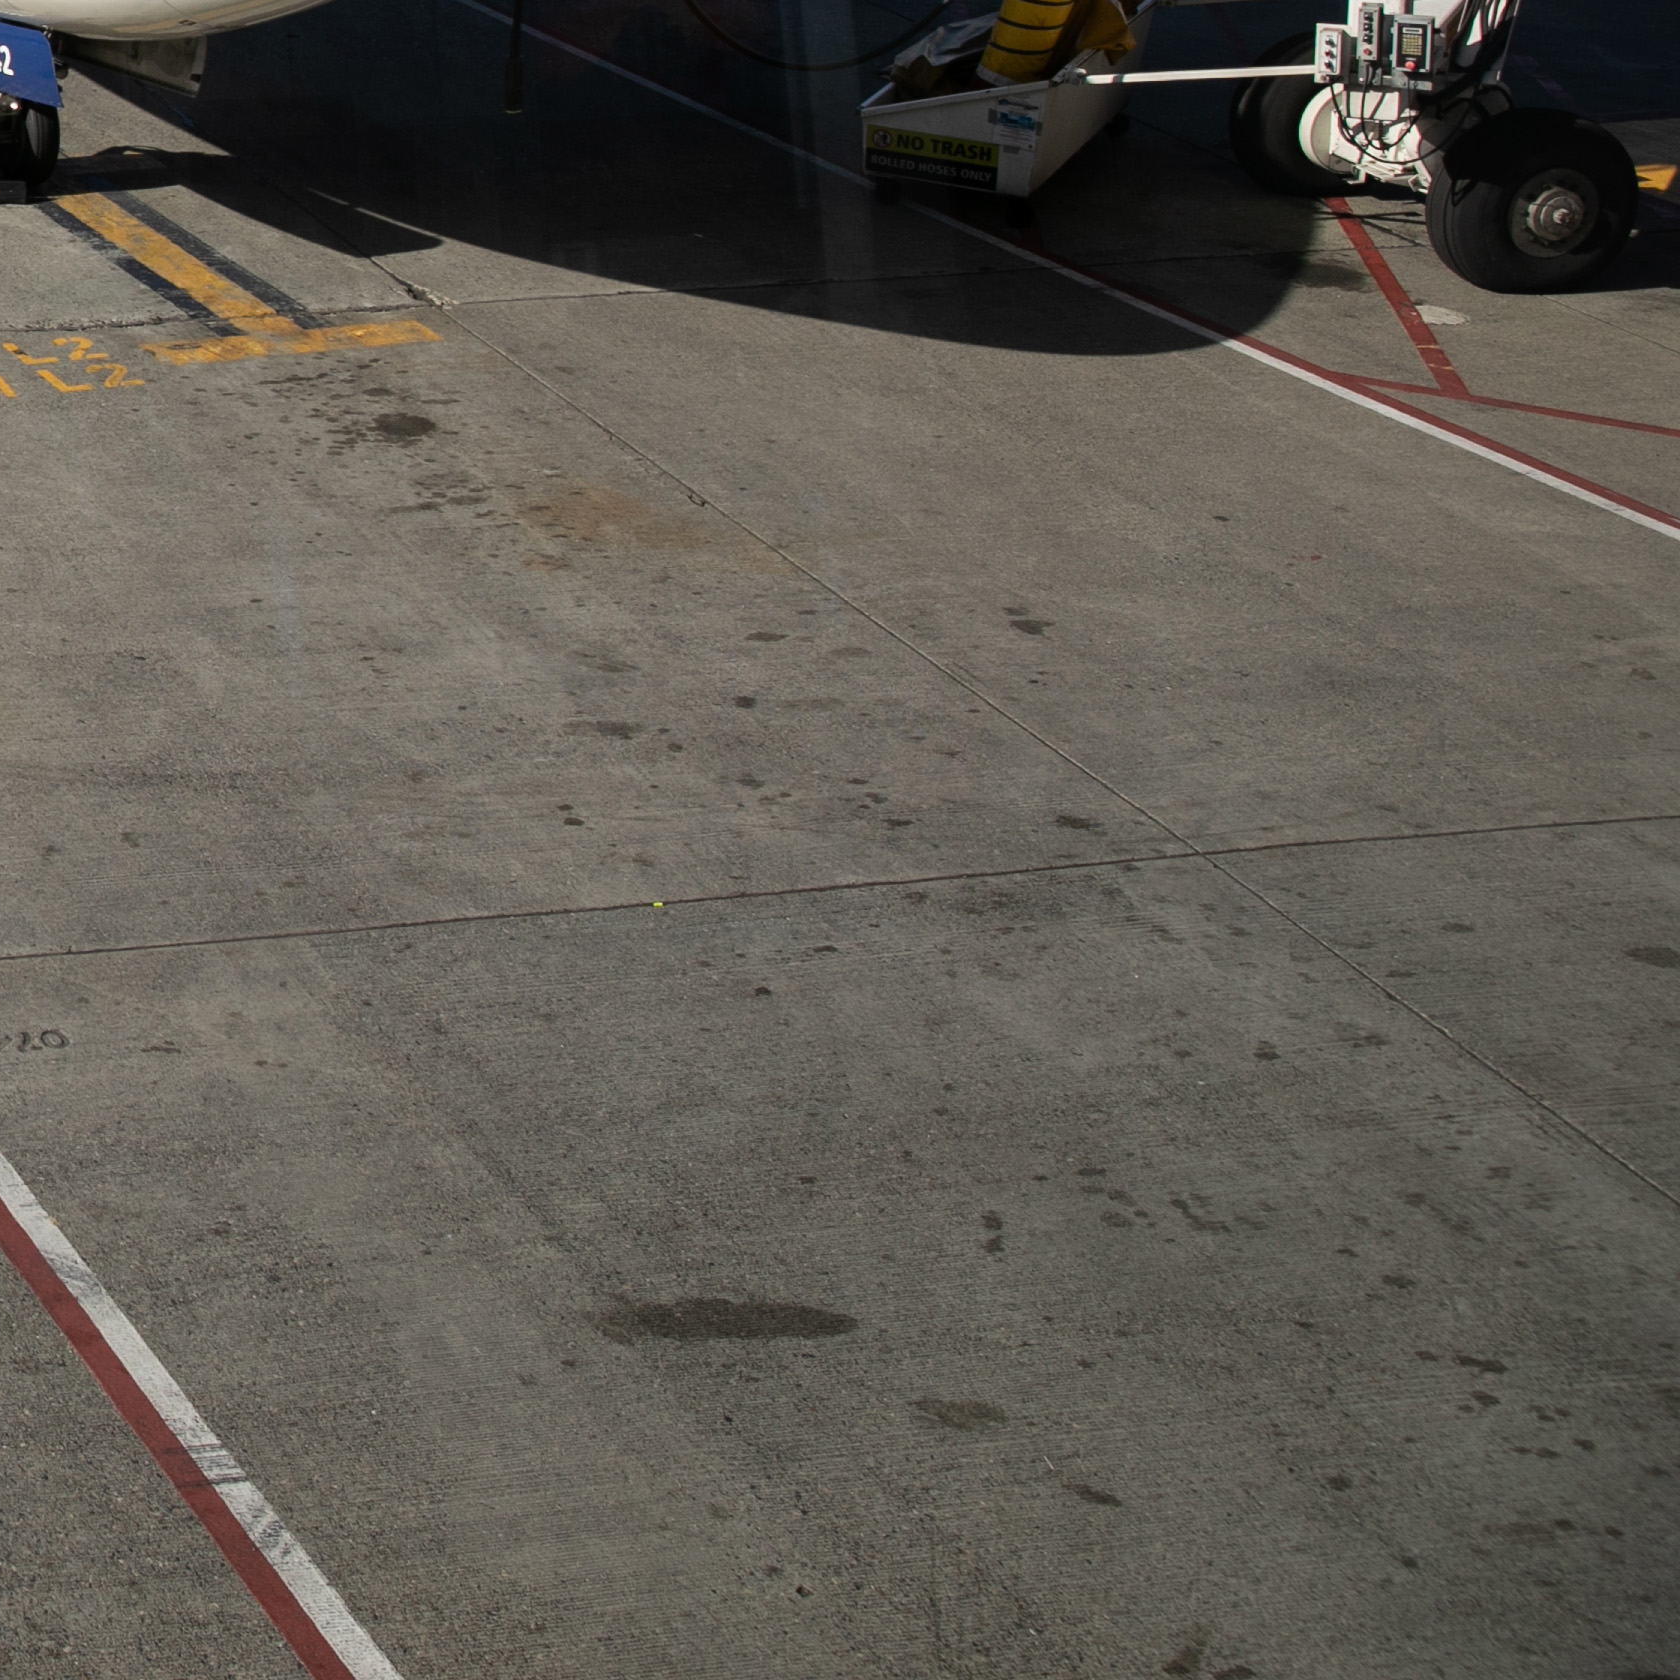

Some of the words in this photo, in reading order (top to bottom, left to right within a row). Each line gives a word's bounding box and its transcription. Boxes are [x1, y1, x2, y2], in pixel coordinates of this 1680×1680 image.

[896, 133, 925, 151] NO
[930, 138, 993, 162] TRASH
[870, 154, 916, 171] ROLLED
[918, 160, 958, 178] HOSES
[960, 169, 992, 183] ONLY
[1, 335, 110, 366] L2
[38, 361, 146, 392] L2
